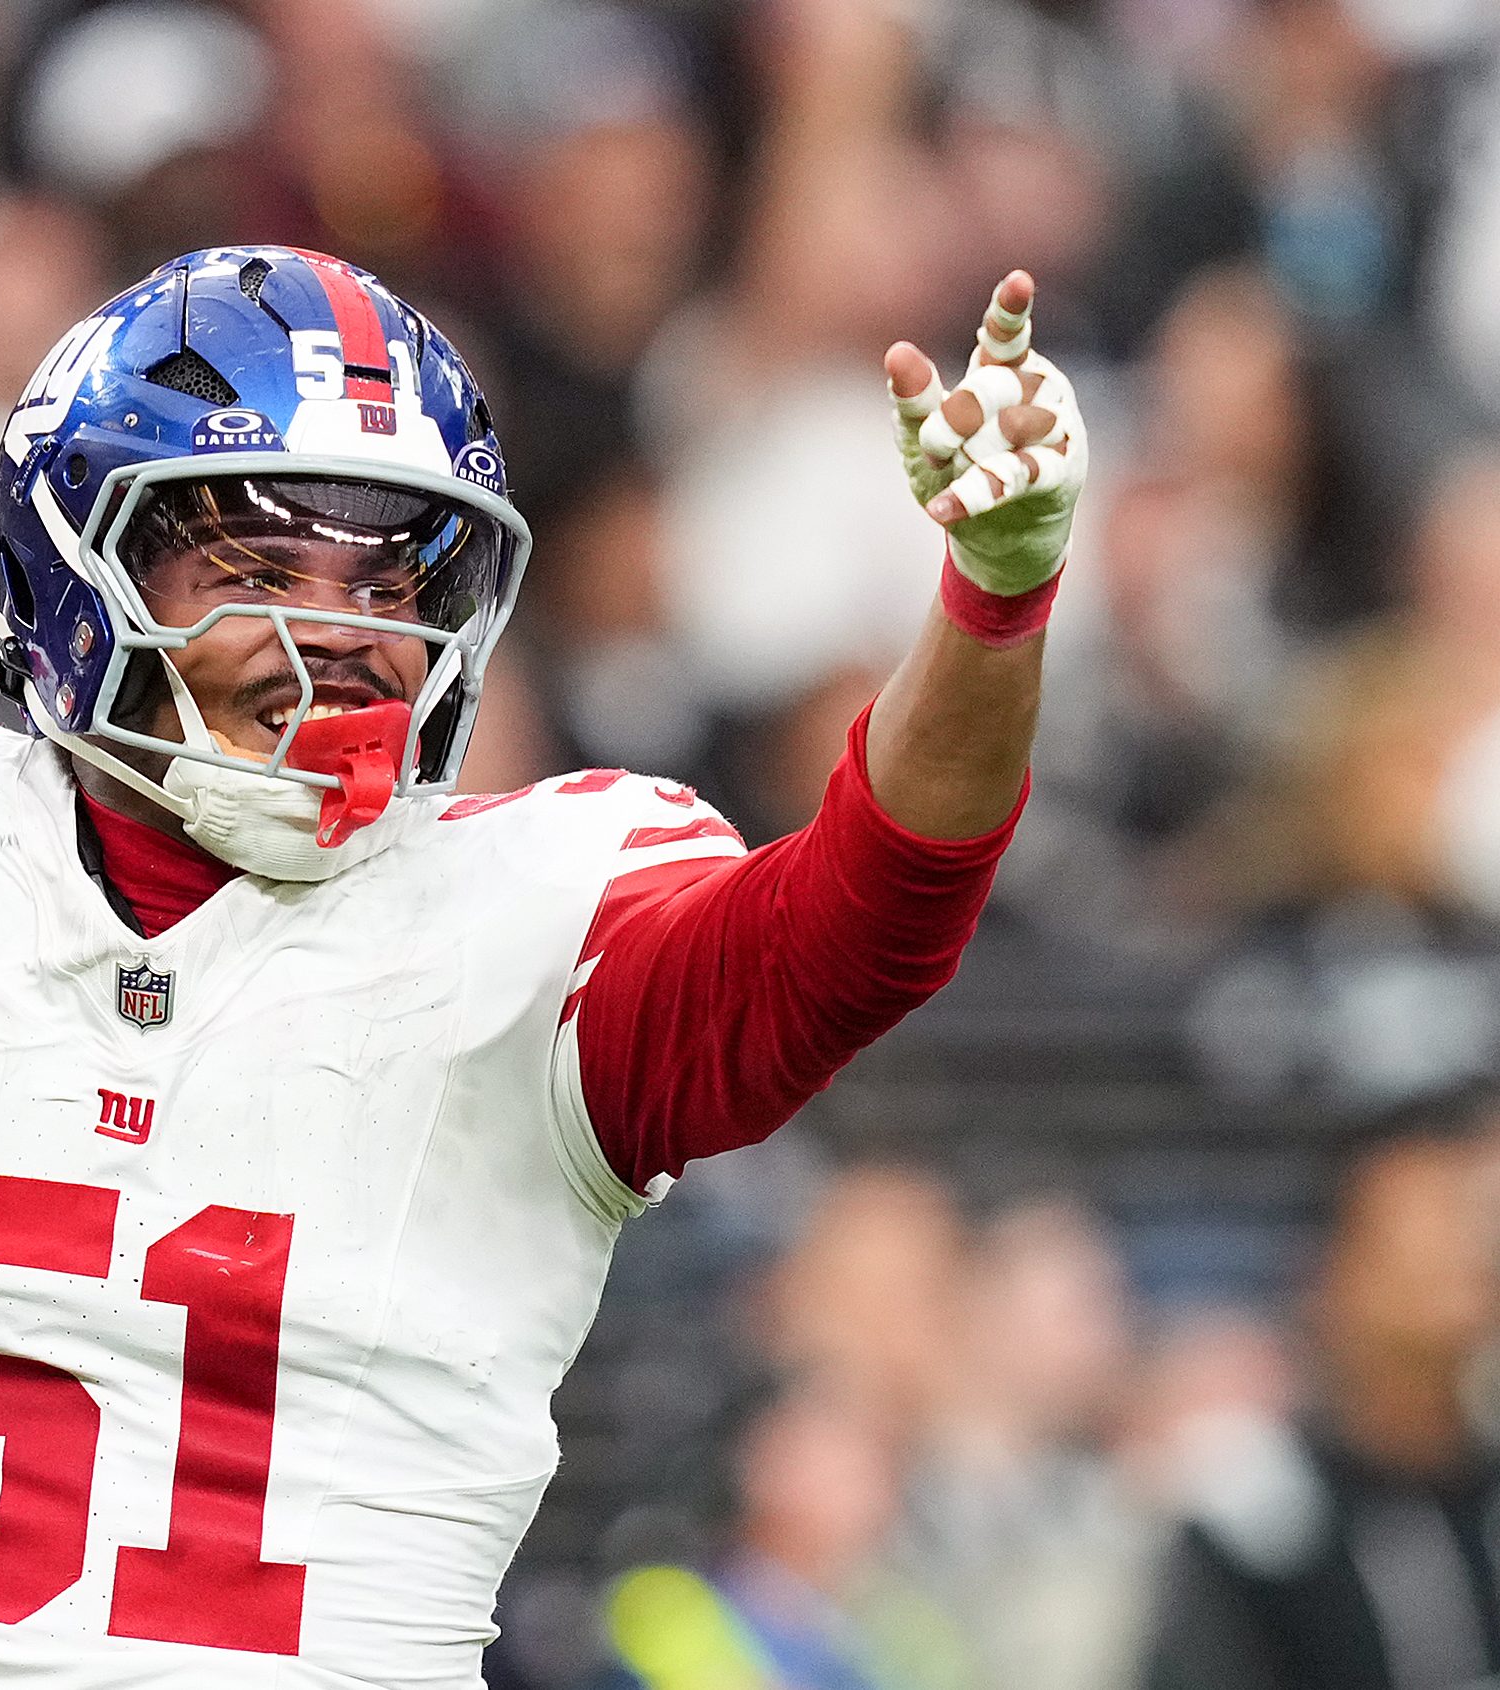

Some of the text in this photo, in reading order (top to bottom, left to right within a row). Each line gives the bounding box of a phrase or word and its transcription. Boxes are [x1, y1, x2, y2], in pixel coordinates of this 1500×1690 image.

[195, 433, 274, 446] OAKLEY
[459, 467, 500, 491] OAKLEY
[123, 990, 163, 1021] NFL
[94, 1088, 155, 1144] ny
